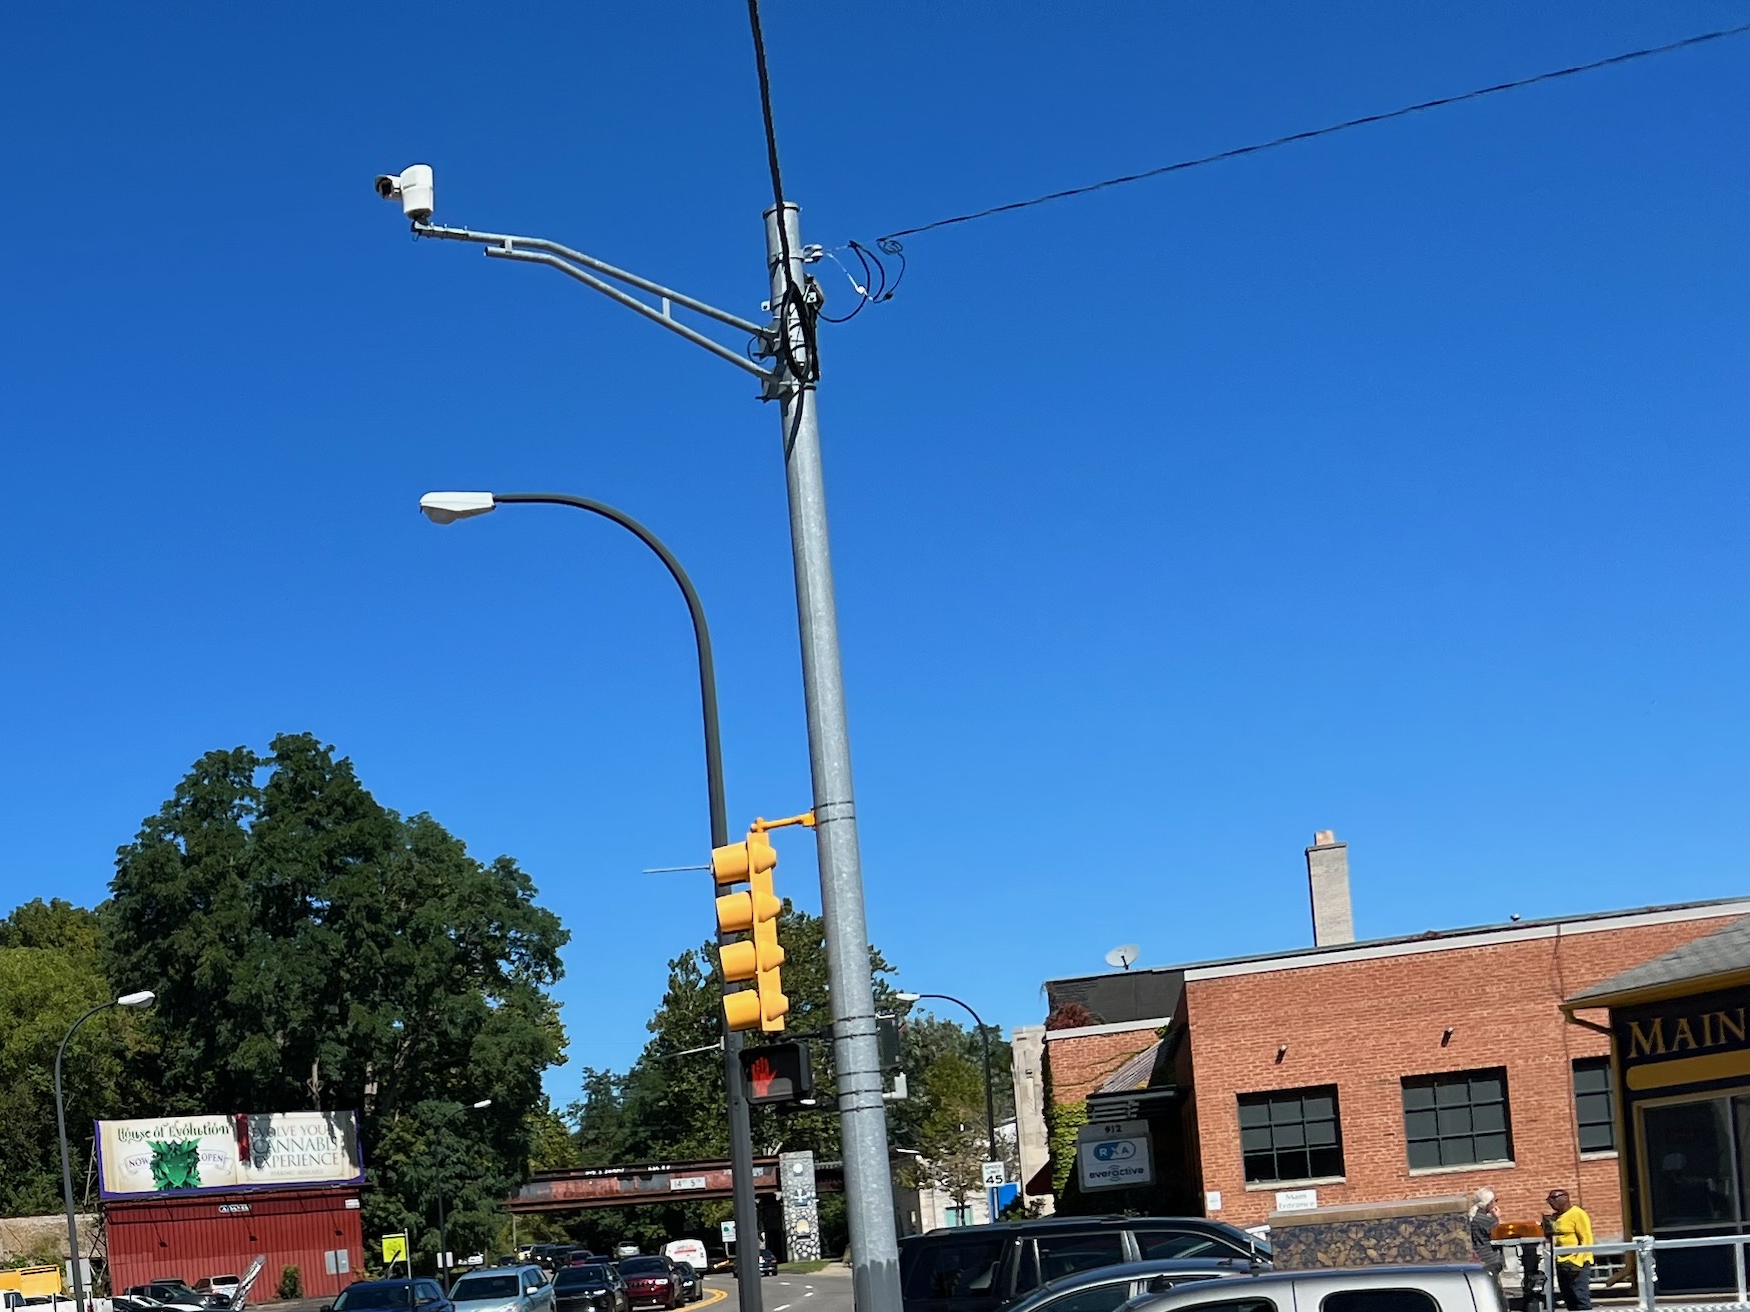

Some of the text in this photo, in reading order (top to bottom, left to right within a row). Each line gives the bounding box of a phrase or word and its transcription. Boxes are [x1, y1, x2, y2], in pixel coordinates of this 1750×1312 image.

[1627, 1008, 1746, 1059] MAIN
[169, 1121, 229, 1138] Evolution
[253, 1137, 338, 1154] CANNABIS
[128, 1153, 224, 1167] NOW OPEN
[255, 1152, 339, 1168] EXPERIENCE
[985, 1174, 1003, 1184] 45
[1090, 1166, 1144, 1179] everactive
